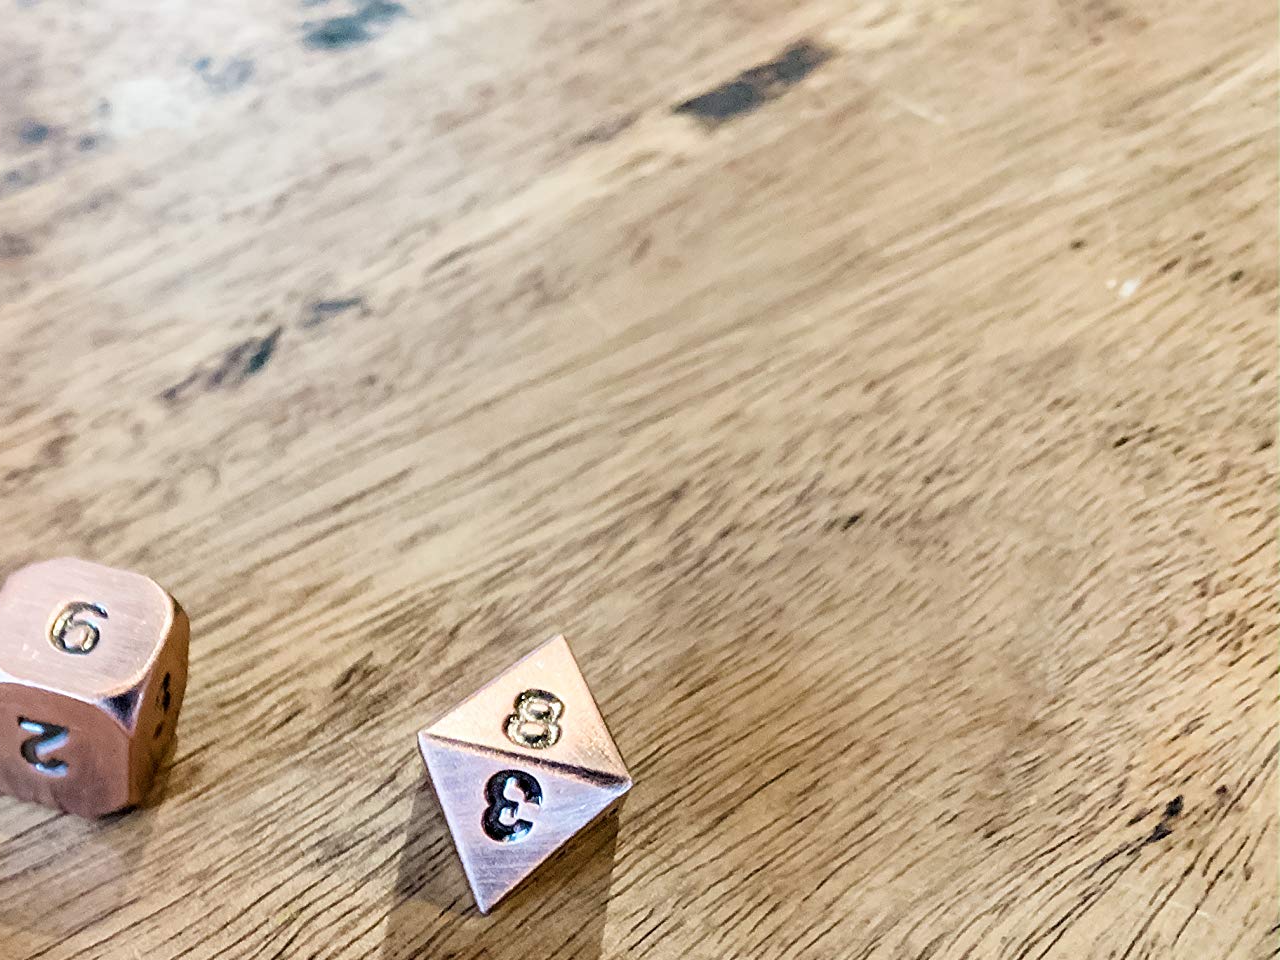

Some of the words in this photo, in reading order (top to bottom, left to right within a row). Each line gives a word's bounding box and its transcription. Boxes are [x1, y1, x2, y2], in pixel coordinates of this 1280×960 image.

[48, 601, 109, 656] 6
[16, 715, 70, 778] 2
[503, 687, 566, 750] 8
[481, 769, 544, 843] 3
